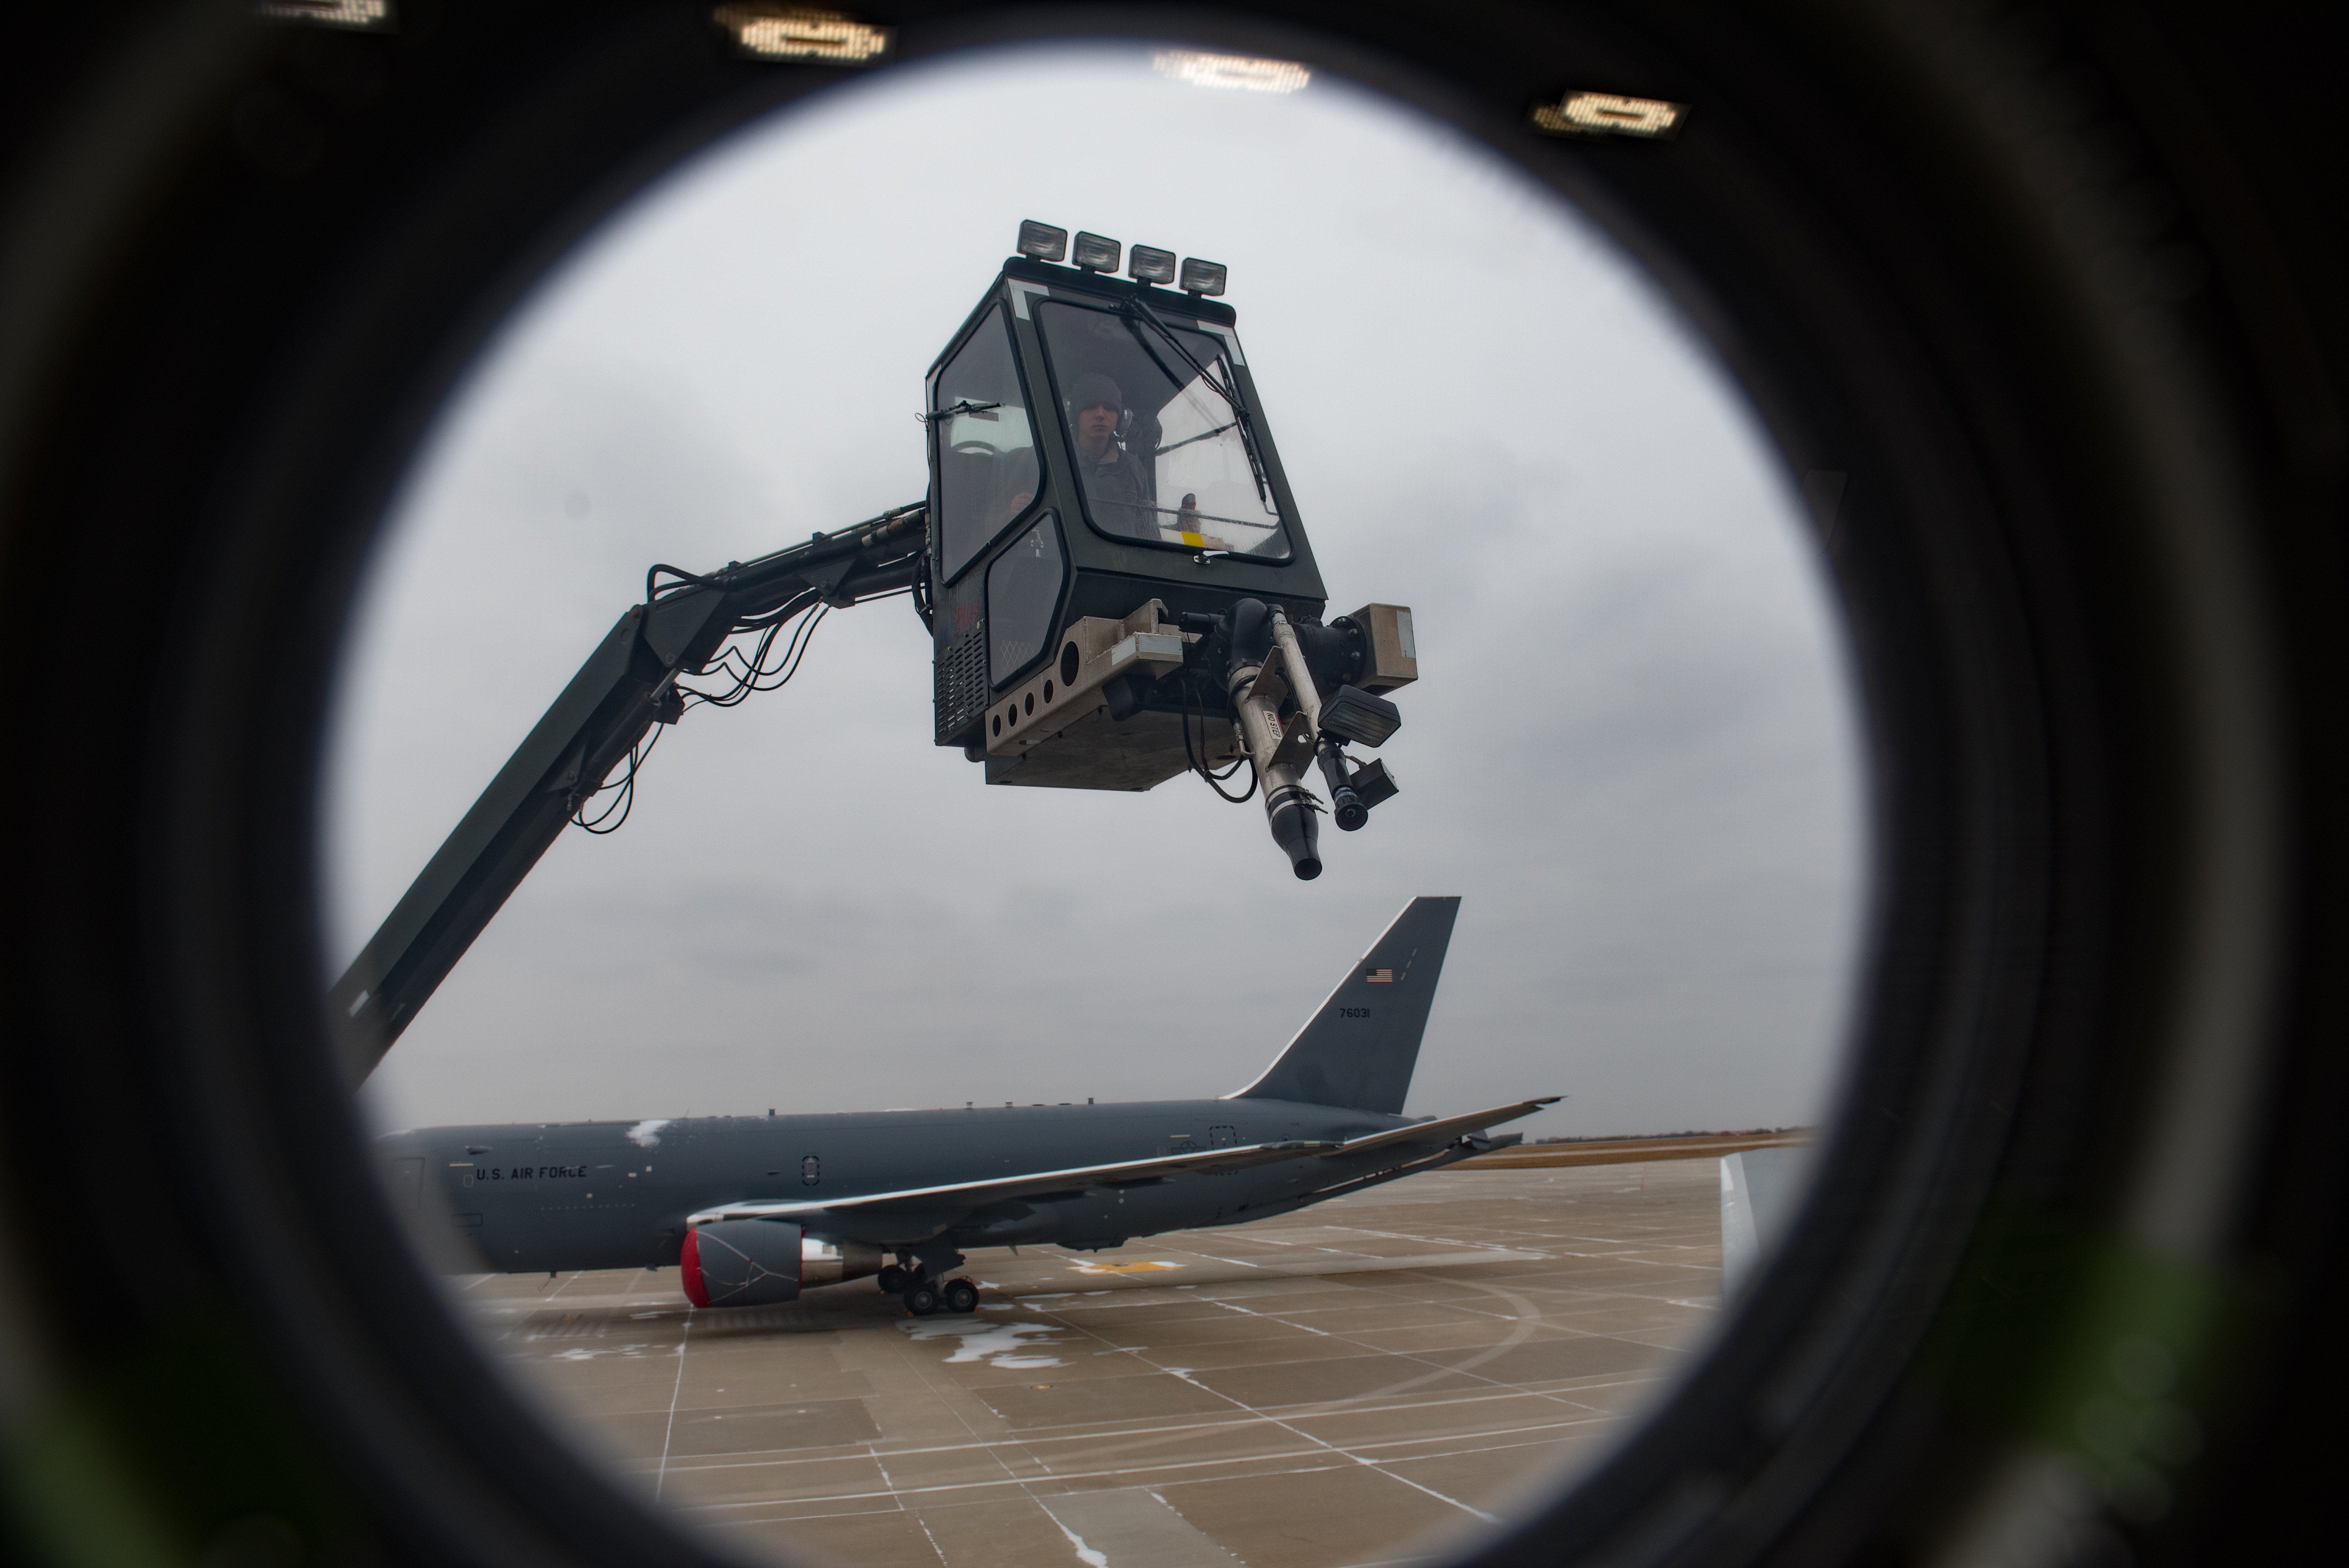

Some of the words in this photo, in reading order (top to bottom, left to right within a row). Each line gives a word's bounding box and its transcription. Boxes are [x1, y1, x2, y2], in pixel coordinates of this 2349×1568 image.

[1267, 713, 1275, 722] NO
[1270, 722, 1281, 738] STEP
[1340, 1008, 1370, 1018] 76031
[476, 1168, 504, 1180] U.S.
[511, 1167, 533, 1179] AIR
[539, 1165, 587, 1178] FORCE
